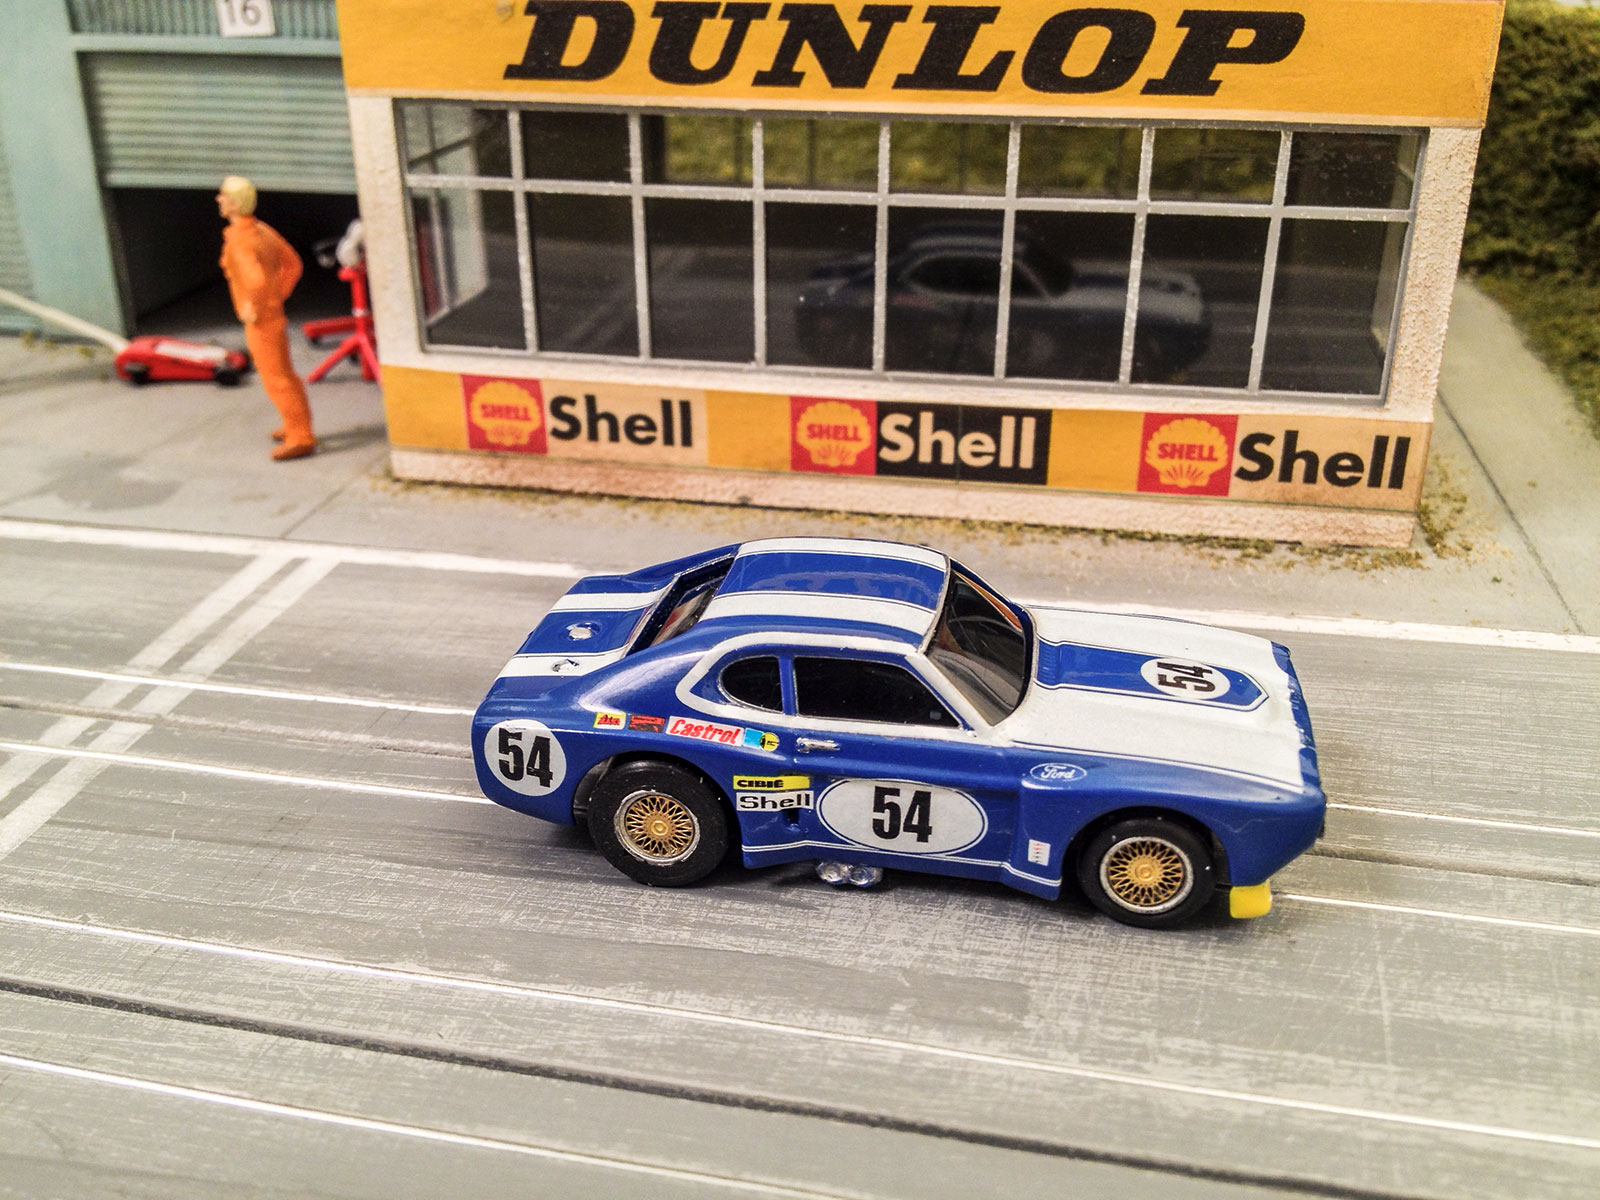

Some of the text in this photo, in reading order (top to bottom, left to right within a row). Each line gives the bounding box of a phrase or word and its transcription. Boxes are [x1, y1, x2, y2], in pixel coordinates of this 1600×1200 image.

[224, 0, 261, 27] 16
[503, 0, 1306, 97] DUNLOP
[549, 394, 693, 447] Shell
[806, 422, 862, 444] SHELL
[878, 411, 1036, 469] Shell
[1157, 442, 1219, 463] SHELL
[1234, 430, 1412, 490] Shell
[1156, 661, 1216, 692] 54
[669, 718, 742, 745] Castrol
[498, 727, 554, 788] 54
[1040, 764, 1077, 779] Ford
[739, 793, 811, 809] Shell
[872, 785, 934, 843] 54
